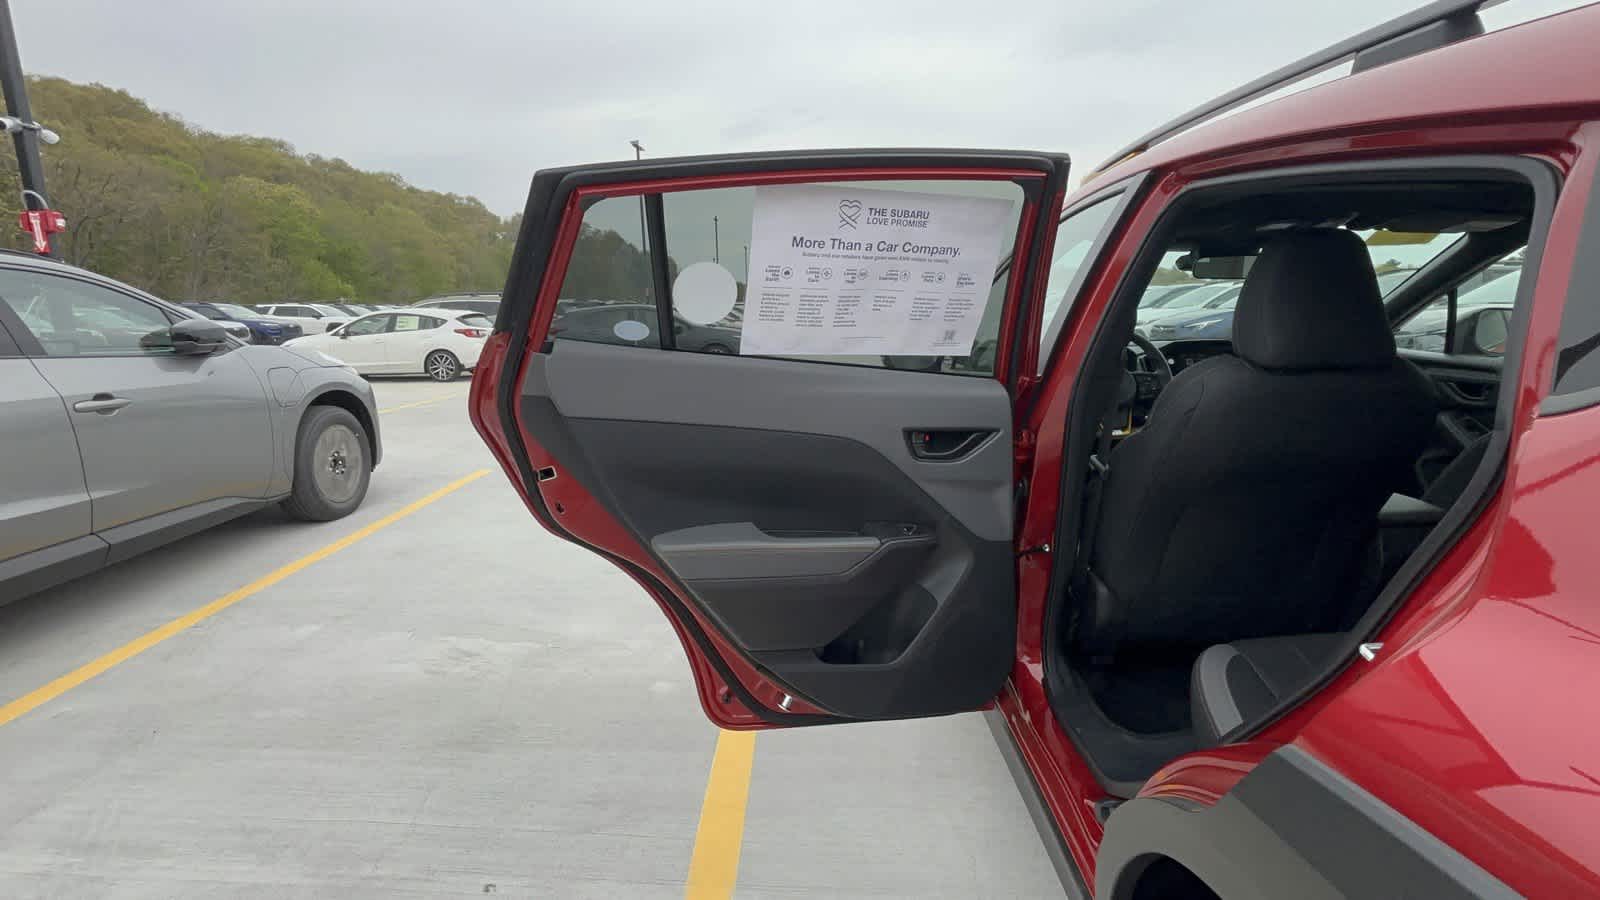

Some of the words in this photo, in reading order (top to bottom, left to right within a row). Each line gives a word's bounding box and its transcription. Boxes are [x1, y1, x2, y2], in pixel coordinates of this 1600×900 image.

[868, 207, 888, 217] THE
[890, 209, 930, 220] SUBARU
[866, 218, 889, 226] LOVE
[890, 219, 929, 228] PROMISE
[791, 236, 826, 249] More
[830, 238, 862, 251] Than
[865, 243, 873, 252] a
[876, 241, 899, 253] Car
[902, 242, 961, 258] Company.
